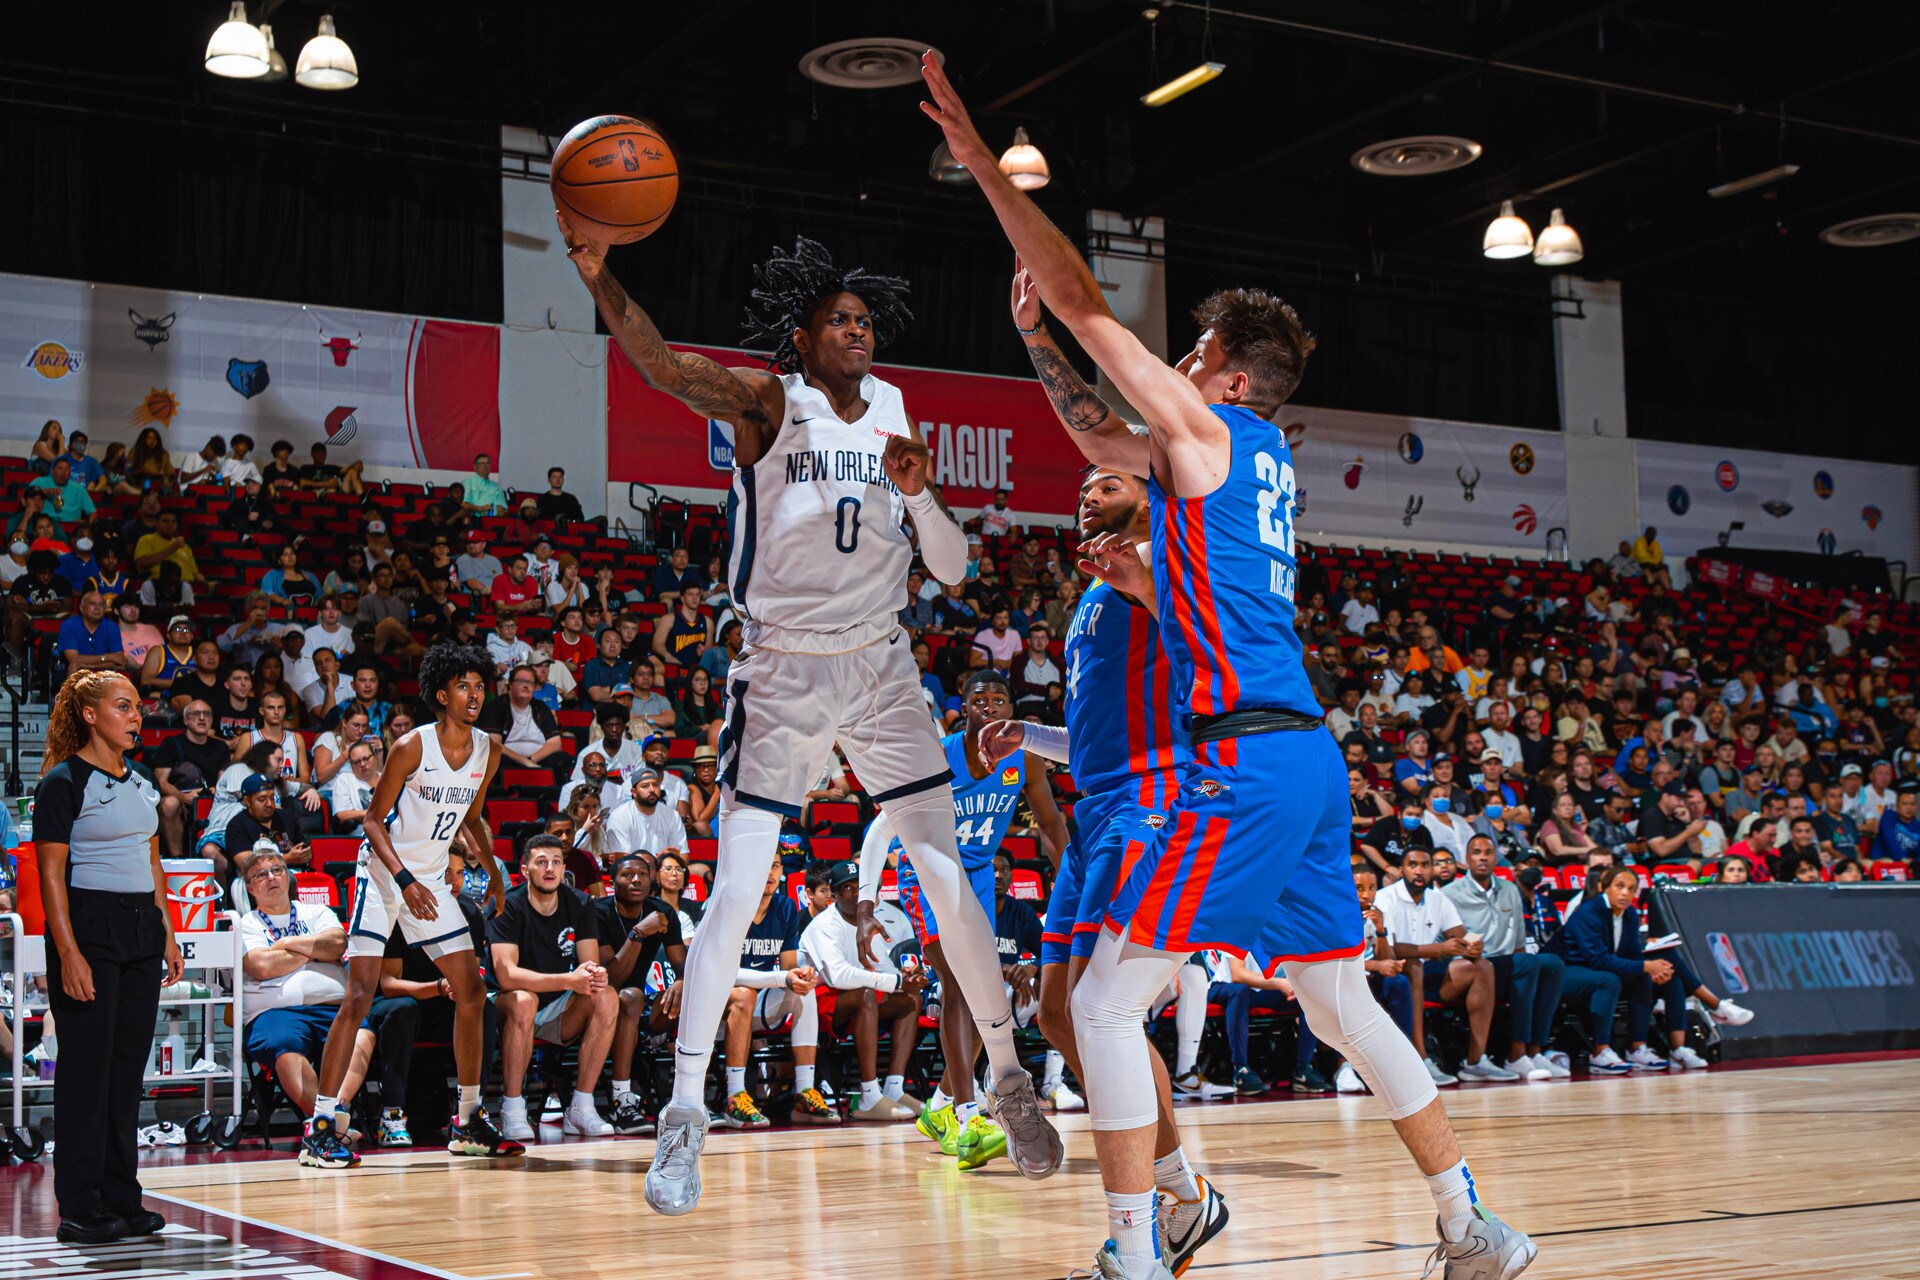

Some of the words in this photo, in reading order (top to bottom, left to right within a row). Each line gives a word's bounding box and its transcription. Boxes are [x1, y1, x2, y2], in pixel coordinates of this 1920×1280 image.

[714, 446, 733, 463] NBA
[785, 449, 828, 485] NEW
[919, 421, 1014, 491] EAGUE
[834, 496, 862, 553] 0
[418, 785, 444, 804] NEW
[954, 792, 1016, 818] HUNDER
[430, 811, 458, 841] 12
[955, 816, 994, 846] 44
[297, 892, 331, 905] SUMMER
[995, 936, 1018, 955] LEANS
[1732, 929, 1915, 991] EXPERIENCES
